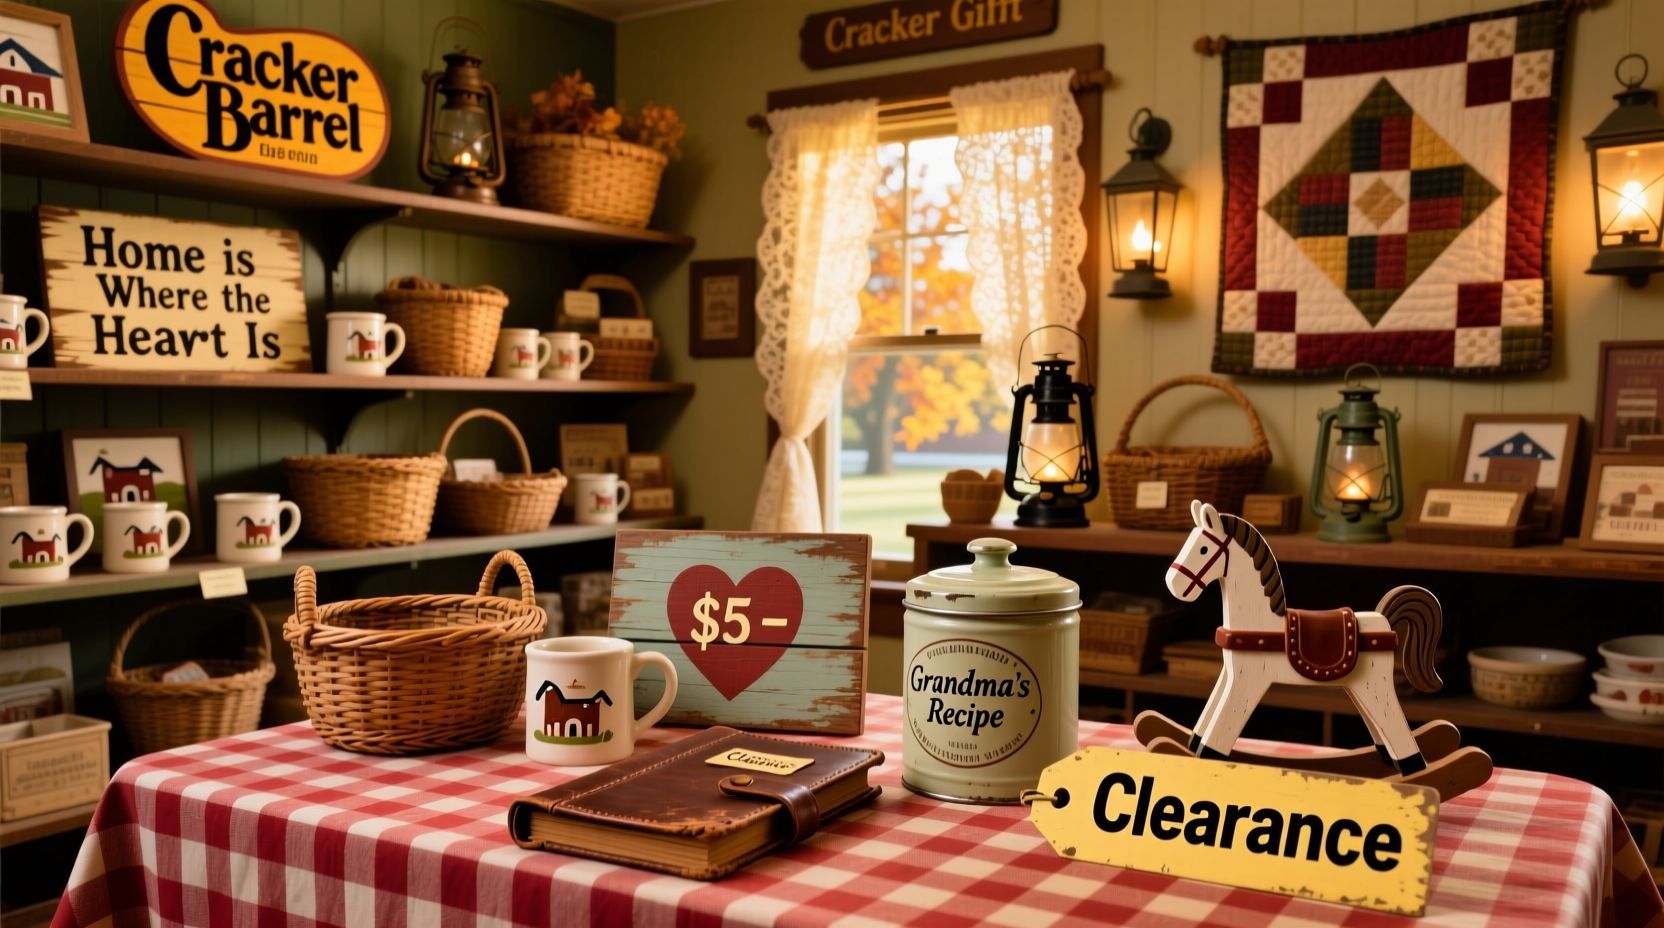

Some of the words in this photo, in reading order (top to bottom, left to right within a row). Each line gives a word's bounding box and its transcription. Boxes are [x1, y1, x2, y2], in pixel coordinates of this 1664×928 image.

[825, 8, 941, 53] Cracker
[145, 4, 359, 103] Cracker
[198, 79, 363, 152] Barrel
[81, 225, 205, 273] Home
[223, 238, 255, 276] is
[96, 273, 208, 310] Where
[221, 283, 271, 314] the
[245, 321, 281, 359] Is
[911, 664, 1030, 698] Grandma's
[927, 697, 1004, 736] Recipe
[1093, 772, 1402, 871] Clearance
